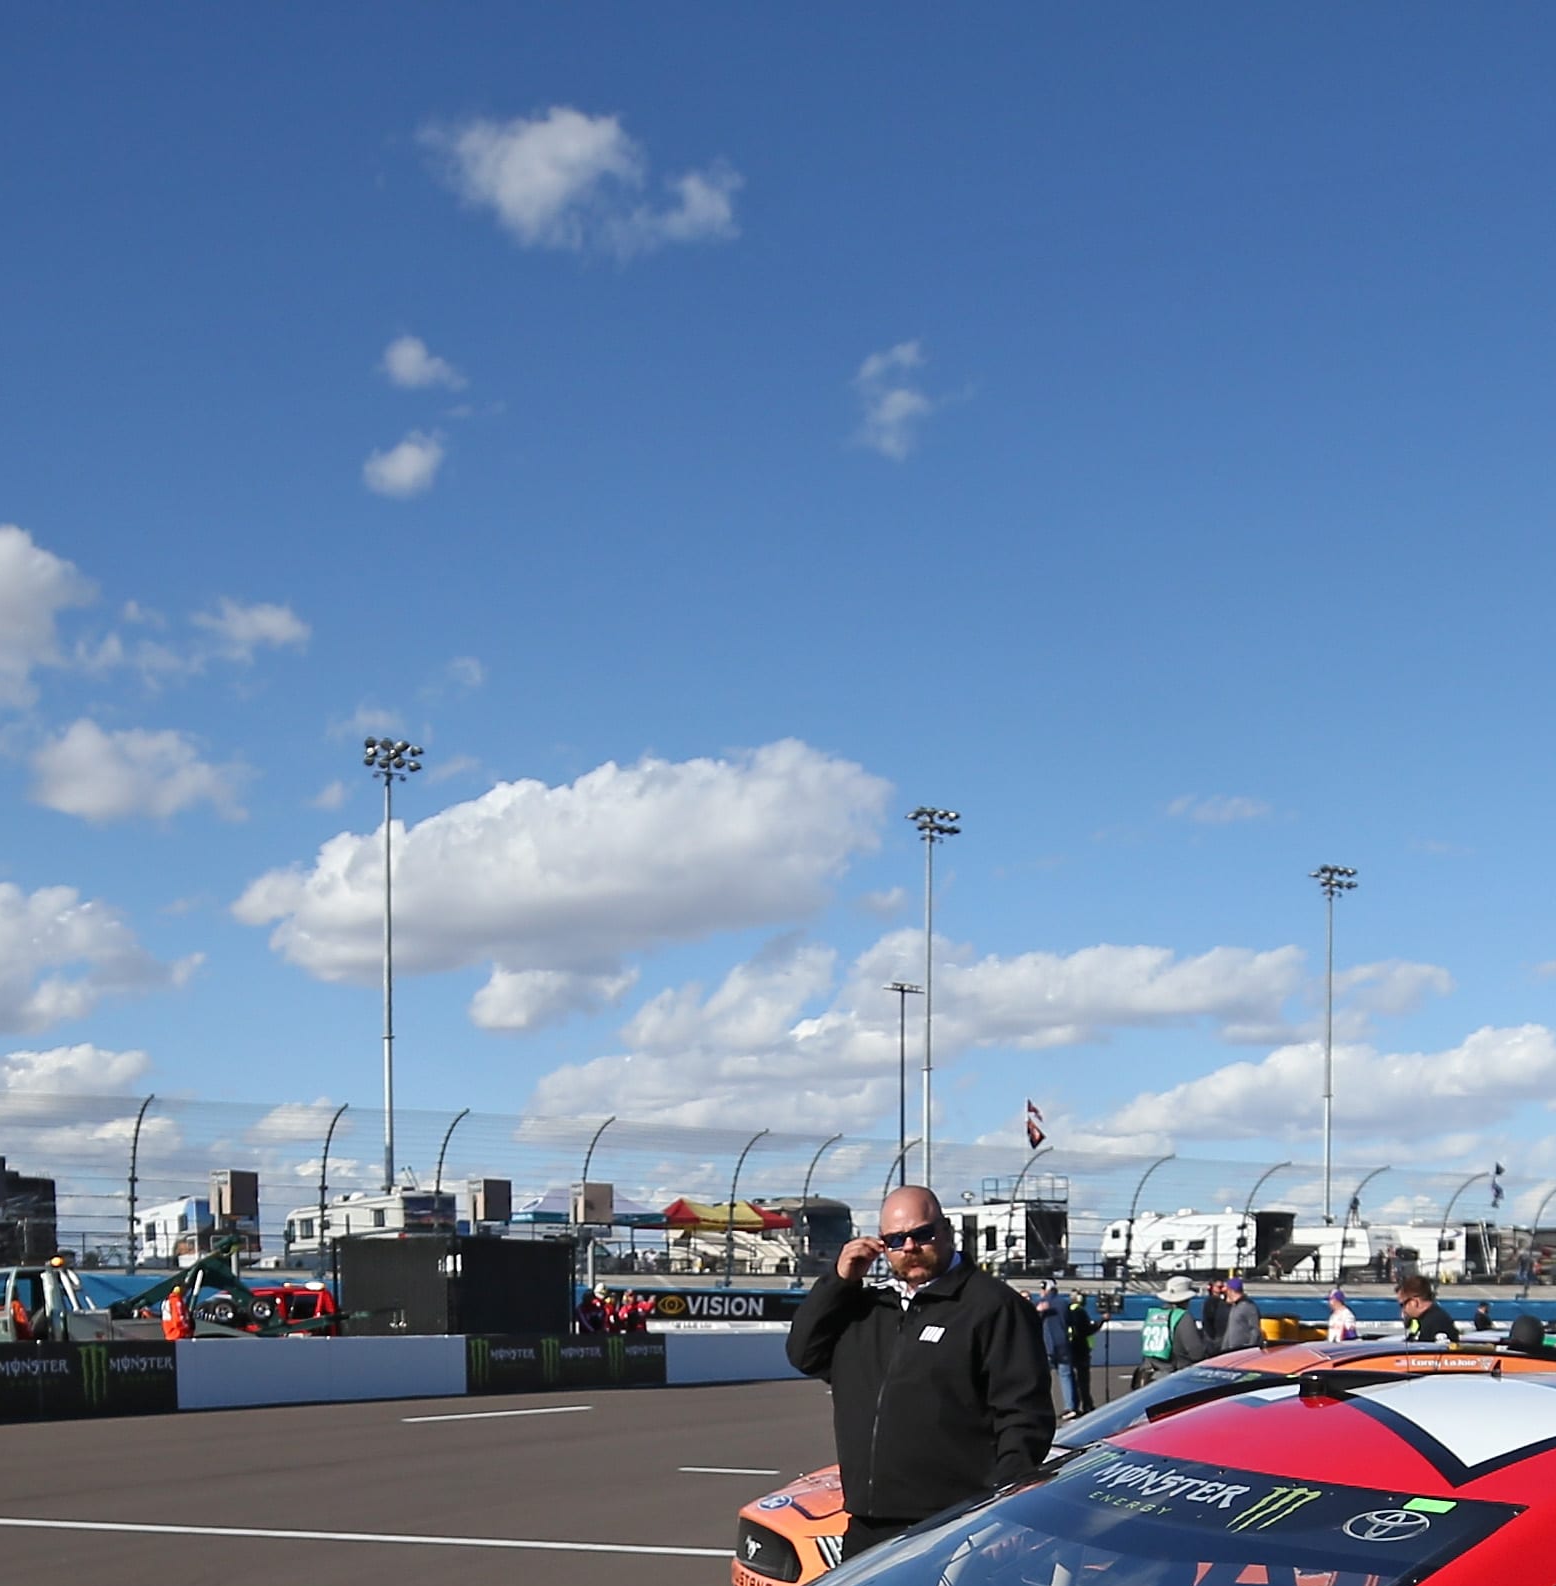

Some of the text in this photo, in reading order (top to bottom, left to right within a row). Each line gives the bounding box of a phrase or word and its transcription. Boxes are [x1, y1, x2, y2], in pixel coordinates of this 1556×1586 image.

[684, 1295, 764, 1316] VISION
[109, 1355, 174, 1372] MONSTER
[1410, 1359, 1441, 1370] Corey
[1092, 1461, 1250, 1509] MONSTER
[1087, 1490, 1173, 1517] ENERGY
